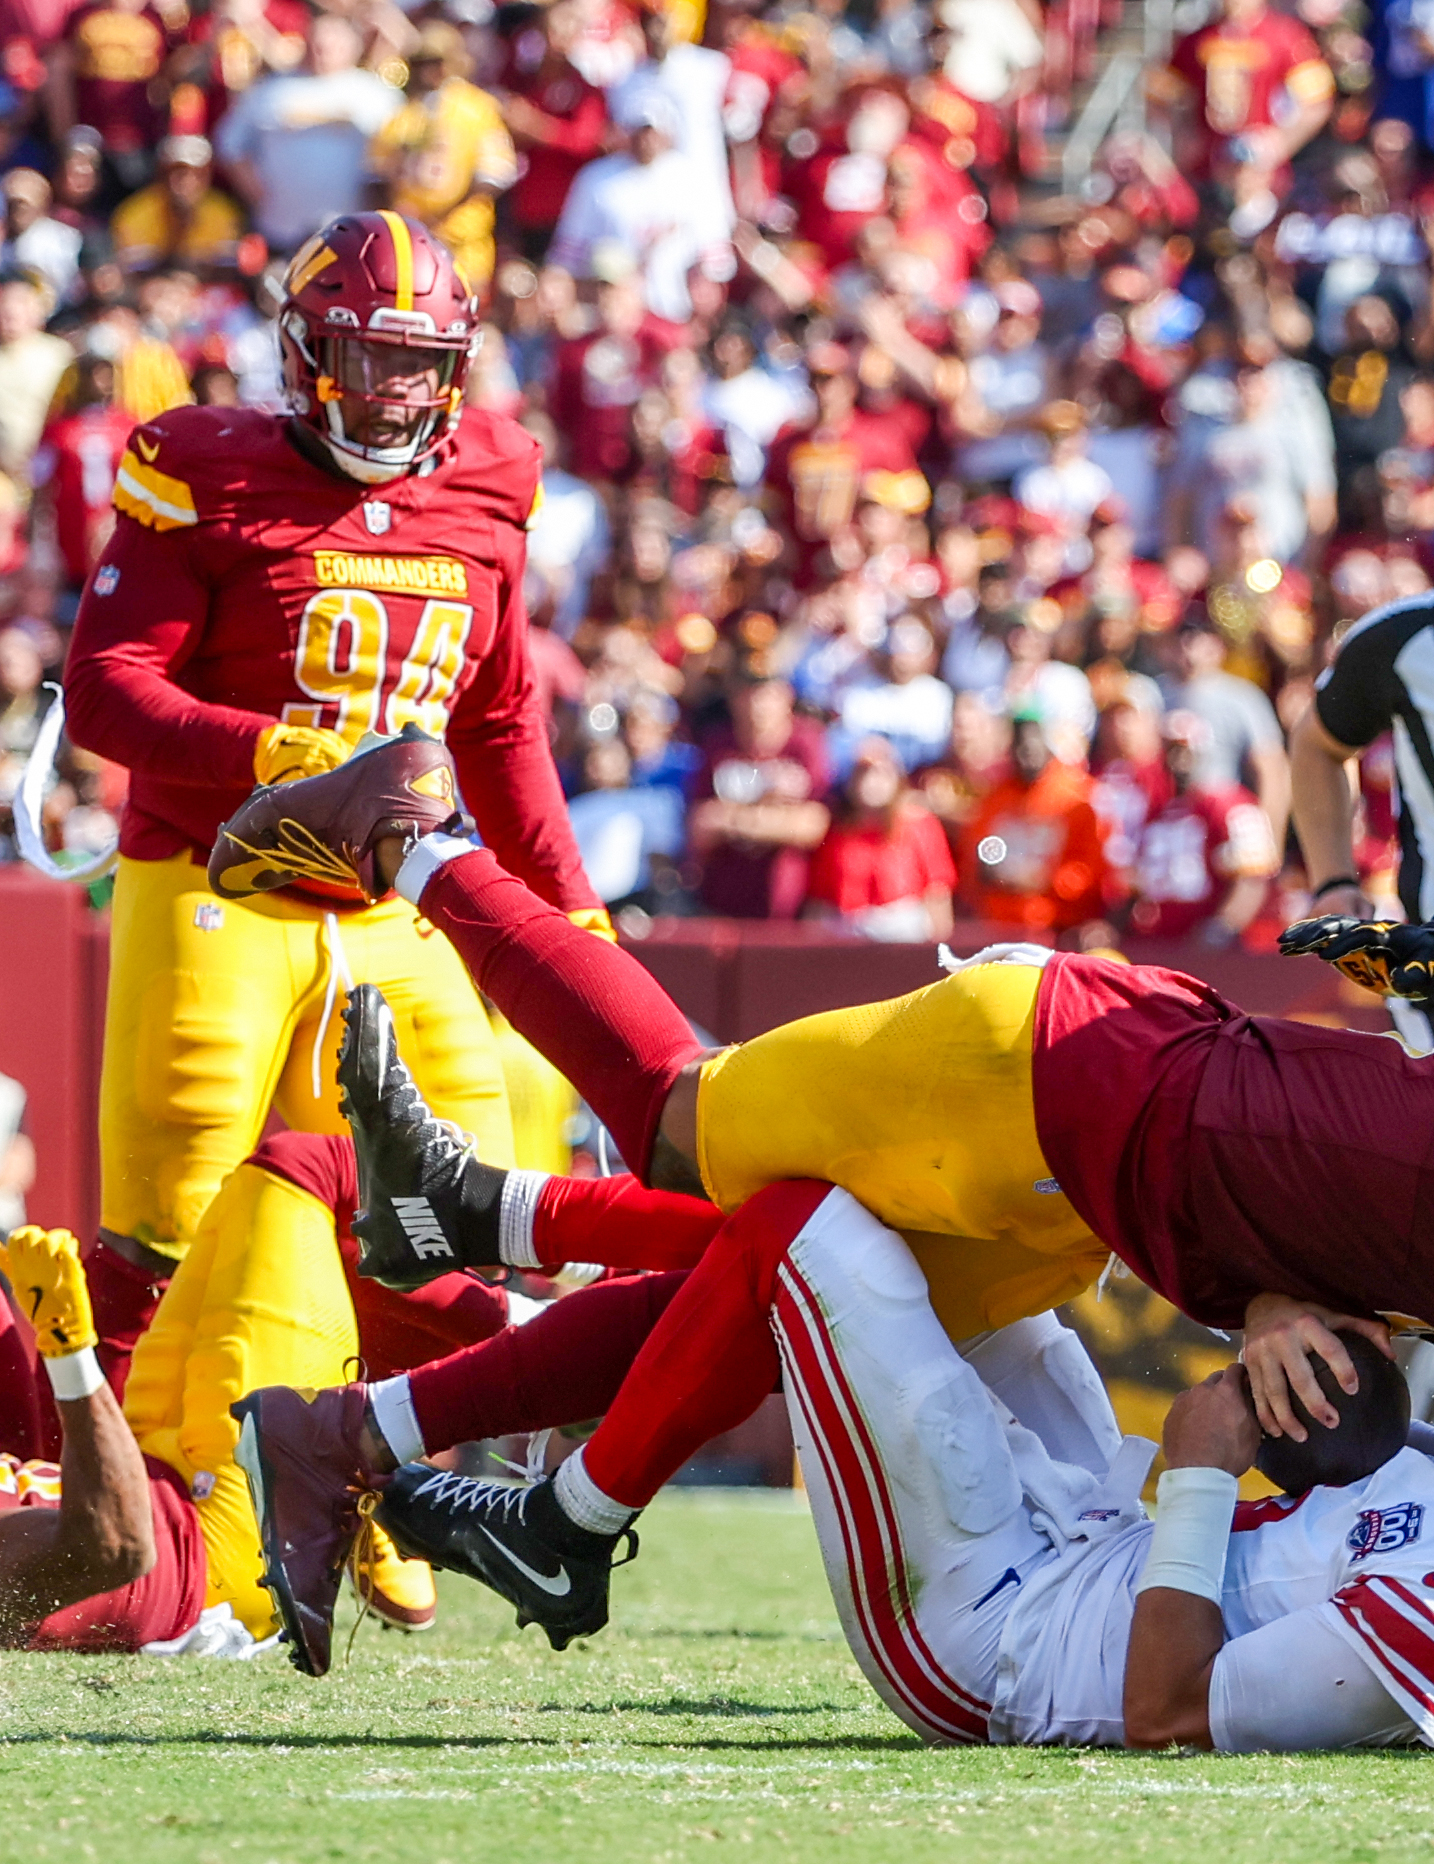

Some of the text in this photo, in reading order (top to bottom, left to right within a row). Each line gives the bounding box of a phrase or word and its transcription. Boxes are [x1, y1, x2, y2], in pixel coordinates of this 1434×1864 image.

[315, 556, 468, 593] COMMANDERS
[281, 588, 474, 738] 94
[390, 1196, 455, 1260] NIKE
